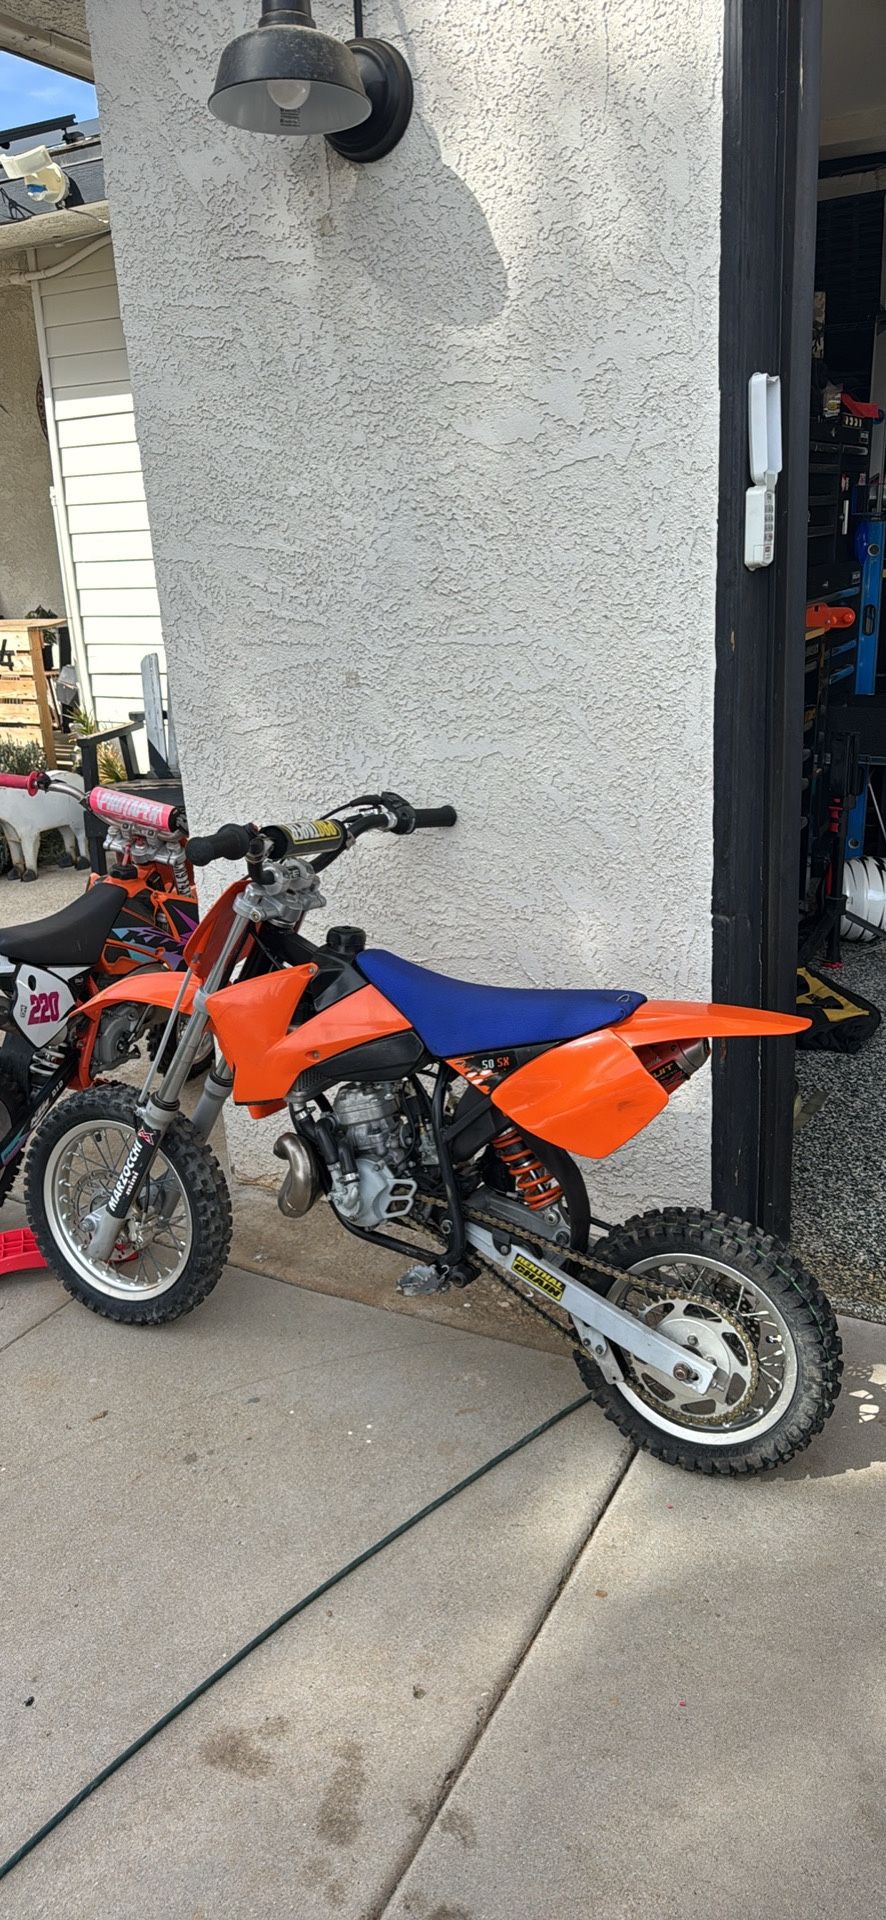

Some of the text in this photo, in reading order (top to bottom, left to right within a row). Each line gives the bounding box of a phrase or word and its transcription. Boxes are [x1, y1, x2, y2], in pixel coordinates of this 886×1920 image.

[27, 991, 60, 1025] 220
[481, 1056, 510, 1070] 50 SX
[108, 1138, 143, 1212] MARZOCCHI
[125, 1170, 139, 1196] mini
[513, 1263, 561, 1297] CHAIN
[516, 1255, 564, 1289] RENTHAL
